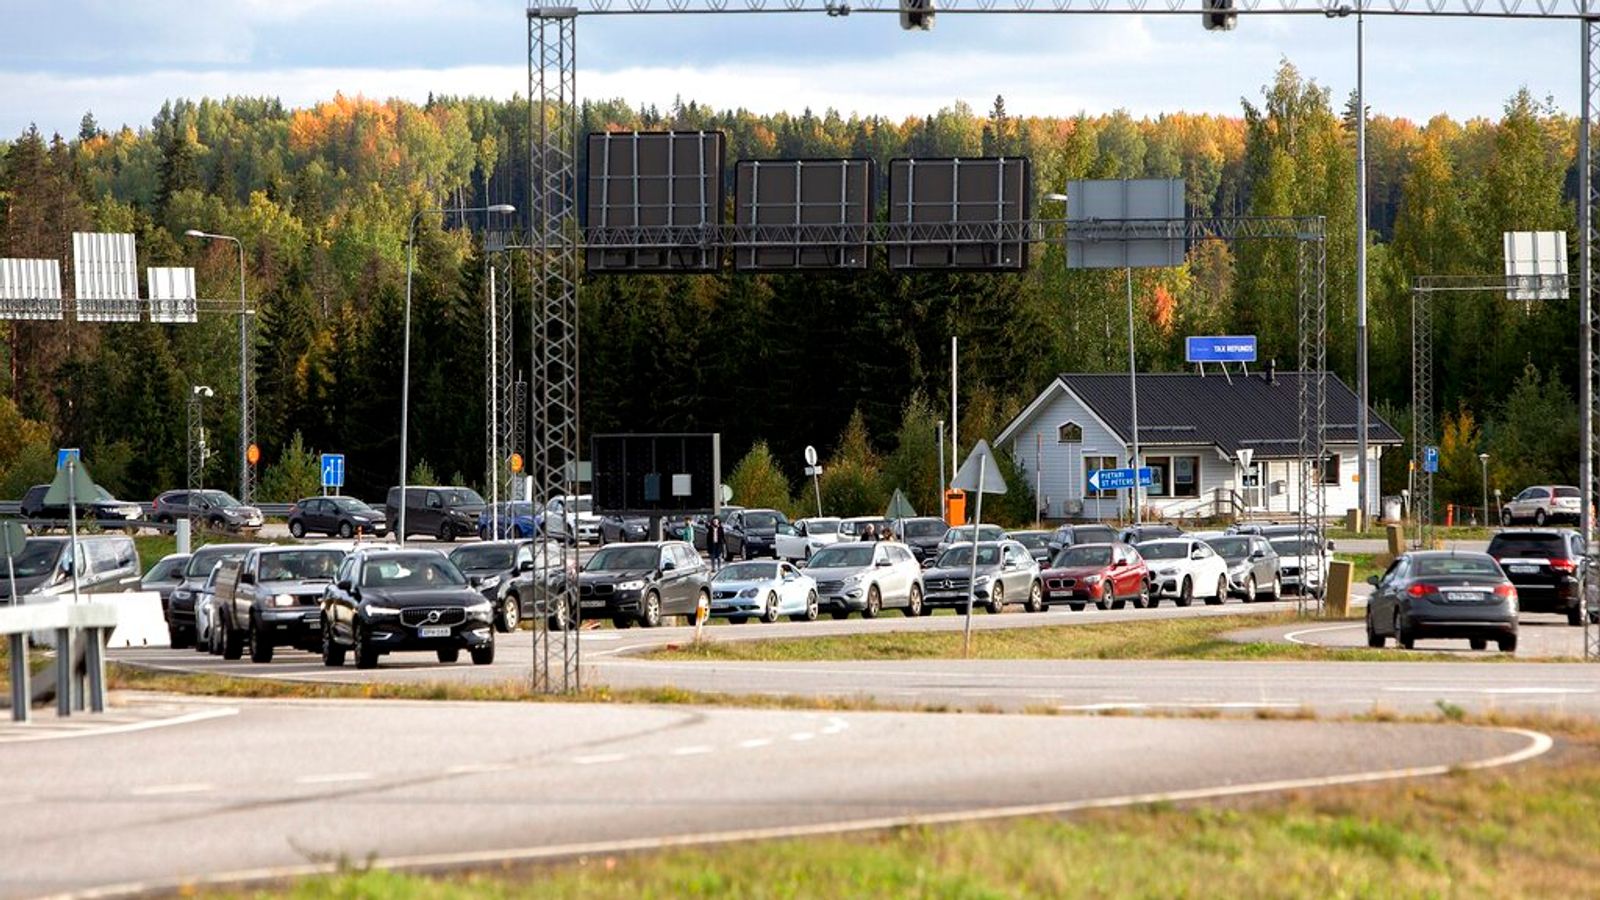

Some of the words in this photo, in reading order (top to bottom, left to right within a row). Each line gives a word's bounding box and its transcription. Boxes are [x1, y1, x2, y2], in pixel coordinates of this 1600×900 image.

[1213, 344, 1226, 353] TAX
[1226, 344, 1254, 353] REFUNDS
[1428, 448, 1436, 461] P
[1101, 479, 1110, 487] ST
